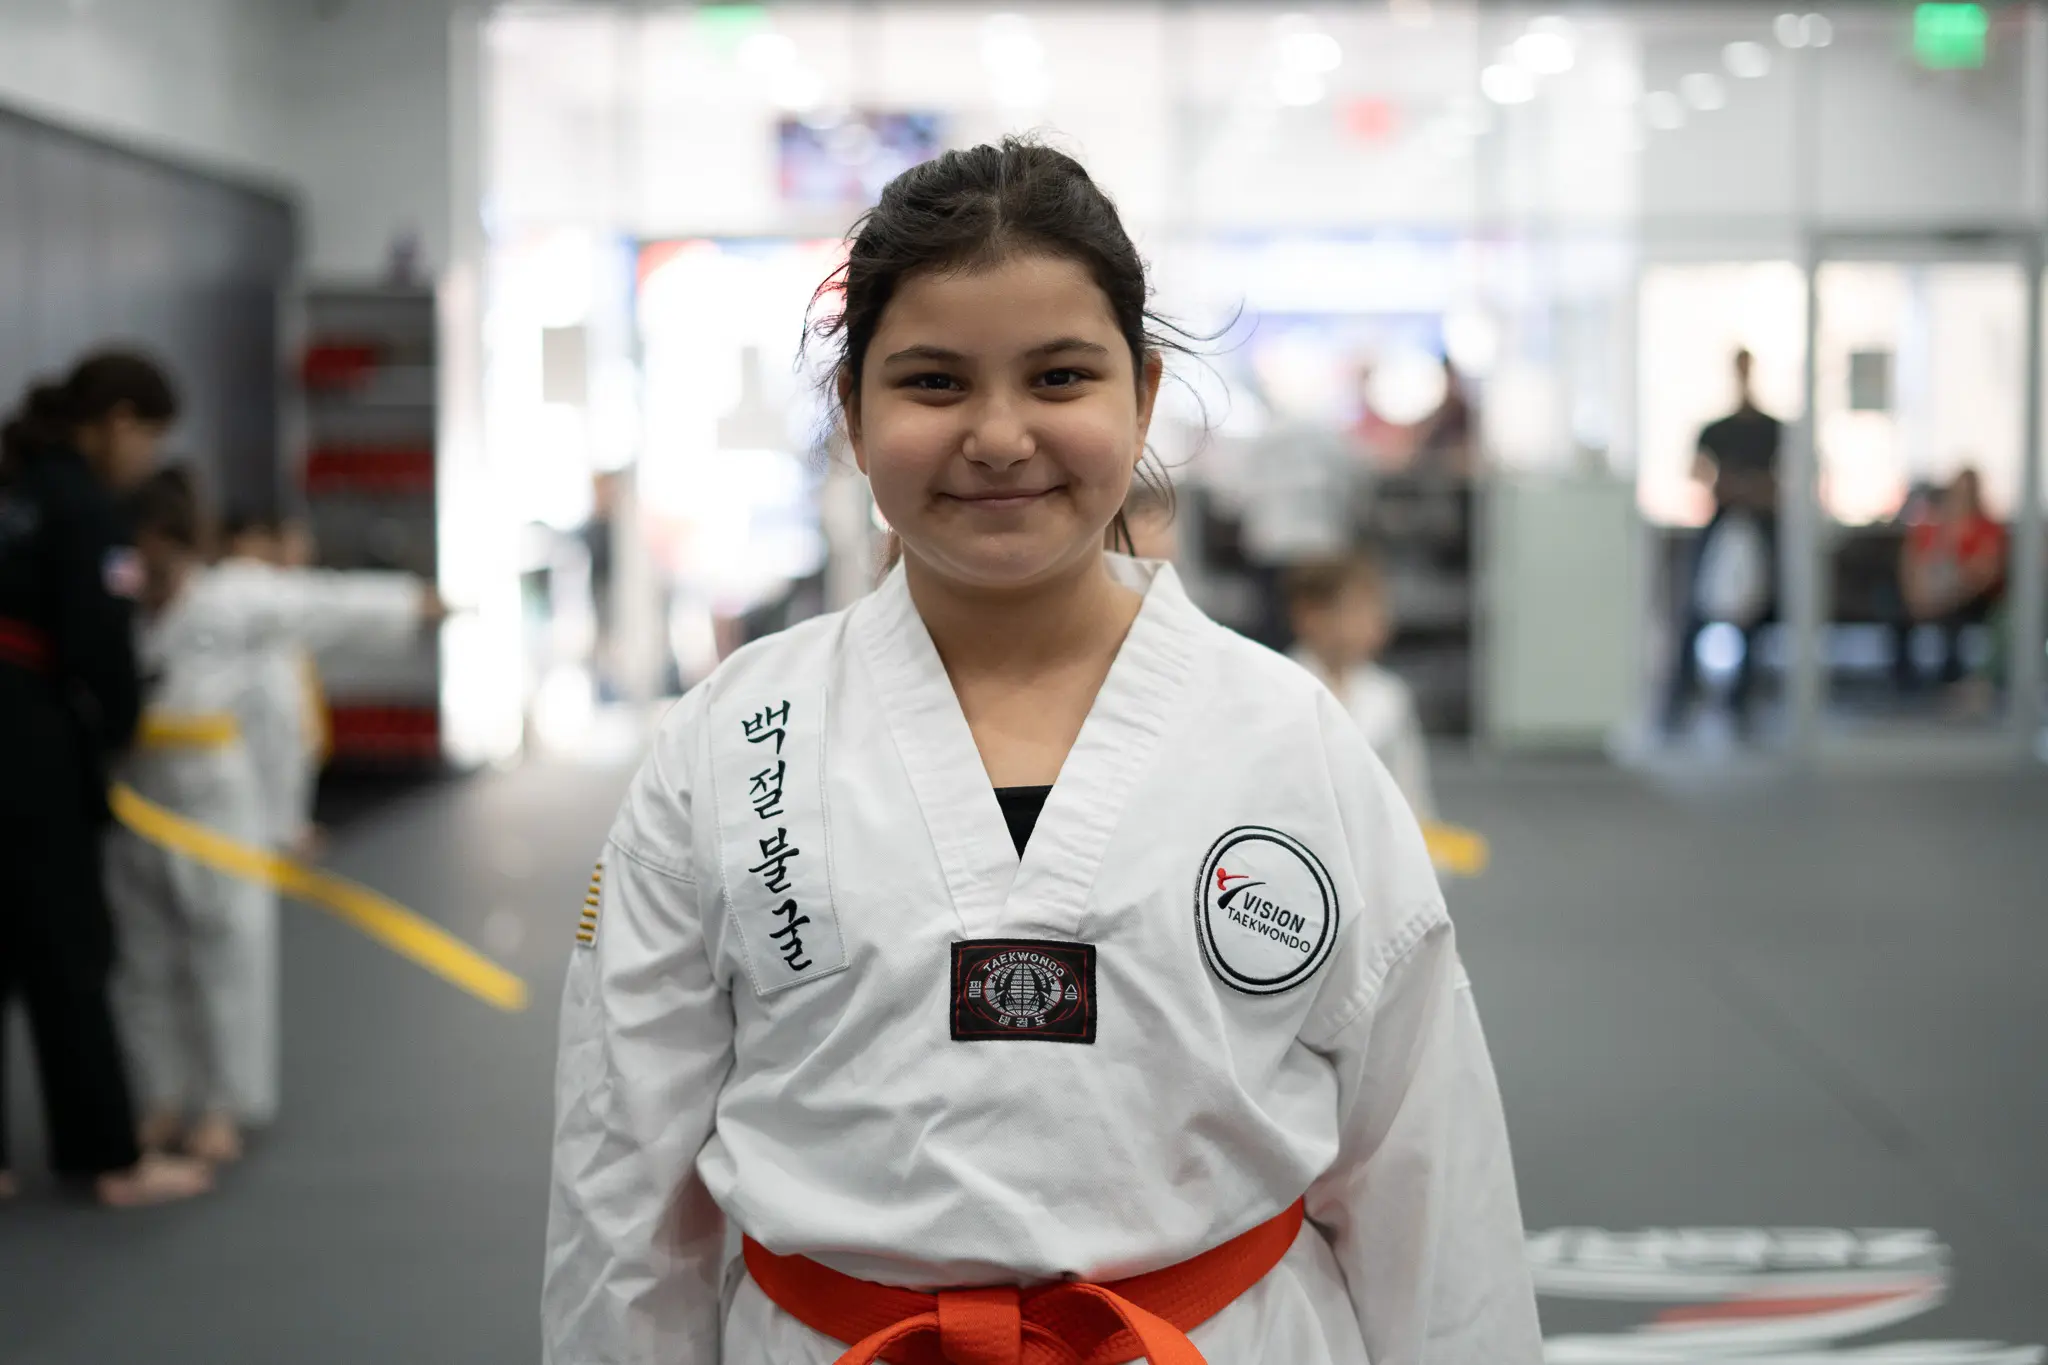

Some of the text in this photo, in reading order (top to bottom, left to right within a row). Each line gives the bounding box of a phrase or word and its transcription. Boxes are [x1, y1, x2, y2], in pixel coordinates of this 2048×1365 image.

[1227, 906, 1311, 953] TAEKWONDO
[1243, 892, 1305, 933] VISION
[983, 951, 1065, 977] TAEKWONDO
